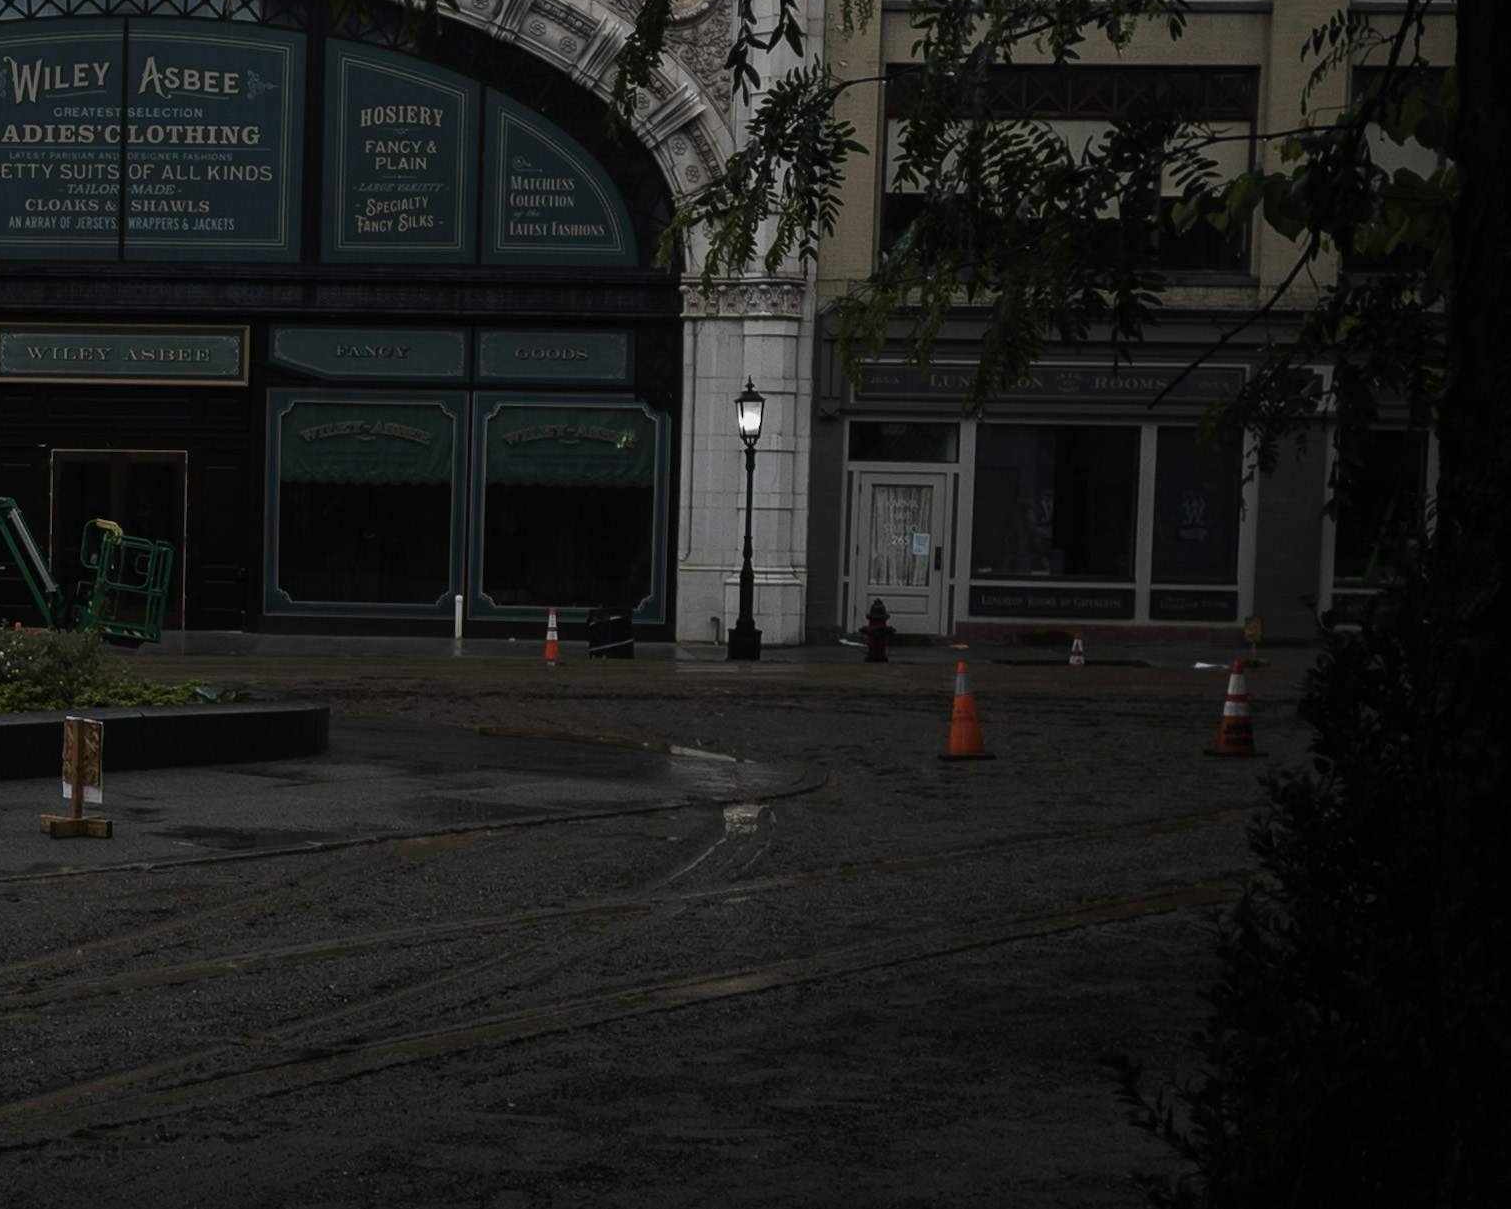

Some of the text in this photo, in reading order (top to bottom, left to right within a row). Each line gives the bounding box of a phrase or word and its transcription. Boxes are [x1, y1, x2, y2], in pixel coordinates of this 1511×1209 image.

[3, 55, 240, 104] WILEY ASBEE
[53, 107, 203, 119] GREATEST SELECTION
[360, 105, 445, 128] HOSIERY
[365, 140, 438, 153] FANCY &
[9, 152, 233, 161] LATEST PARISIAN AND DESIGNER FASHIONS
[376, 157, 428, 170] PLAIN
[60, 163, 120, 180] SUITS
[128, 164, 153, 180] OF
[162, 164, 201, 180] ALL
[207, 165, 273, 182] KINDS
[357, 183, 444, 192] LARGE VARIETY
[510, 175, 575, 191] MATCHLESS
[24, 199, 210, 213] CLOAKS & SHAWLS
[366, 196, 429, 216] SPECIALTY
[510, 192, 575, 207] COLLECTION
[9, 216, 22, 230] AN
[24, 216, 58, 230] ARRAY
[60, 216, 71, 230] OF
[129, 217, 181, 230] WRAPPERS
[182, 217, 189, 230] &
[192, 217, 235, 230] JACKETS
[355, 213, 434, 233] FANCY SILKS
[509, 221, 605, 237] LATEST FASHIONS
[26, 347, 212, 363] WILEY ASBEE
[335, 345, 410, 359] FANCY
[515, 347, 590, 362] GOODS
[930, 375, 1043, 390] LUNON
[1093, 376, 1168, 391] ROOMS
[891, 535, 911, 545] 265
